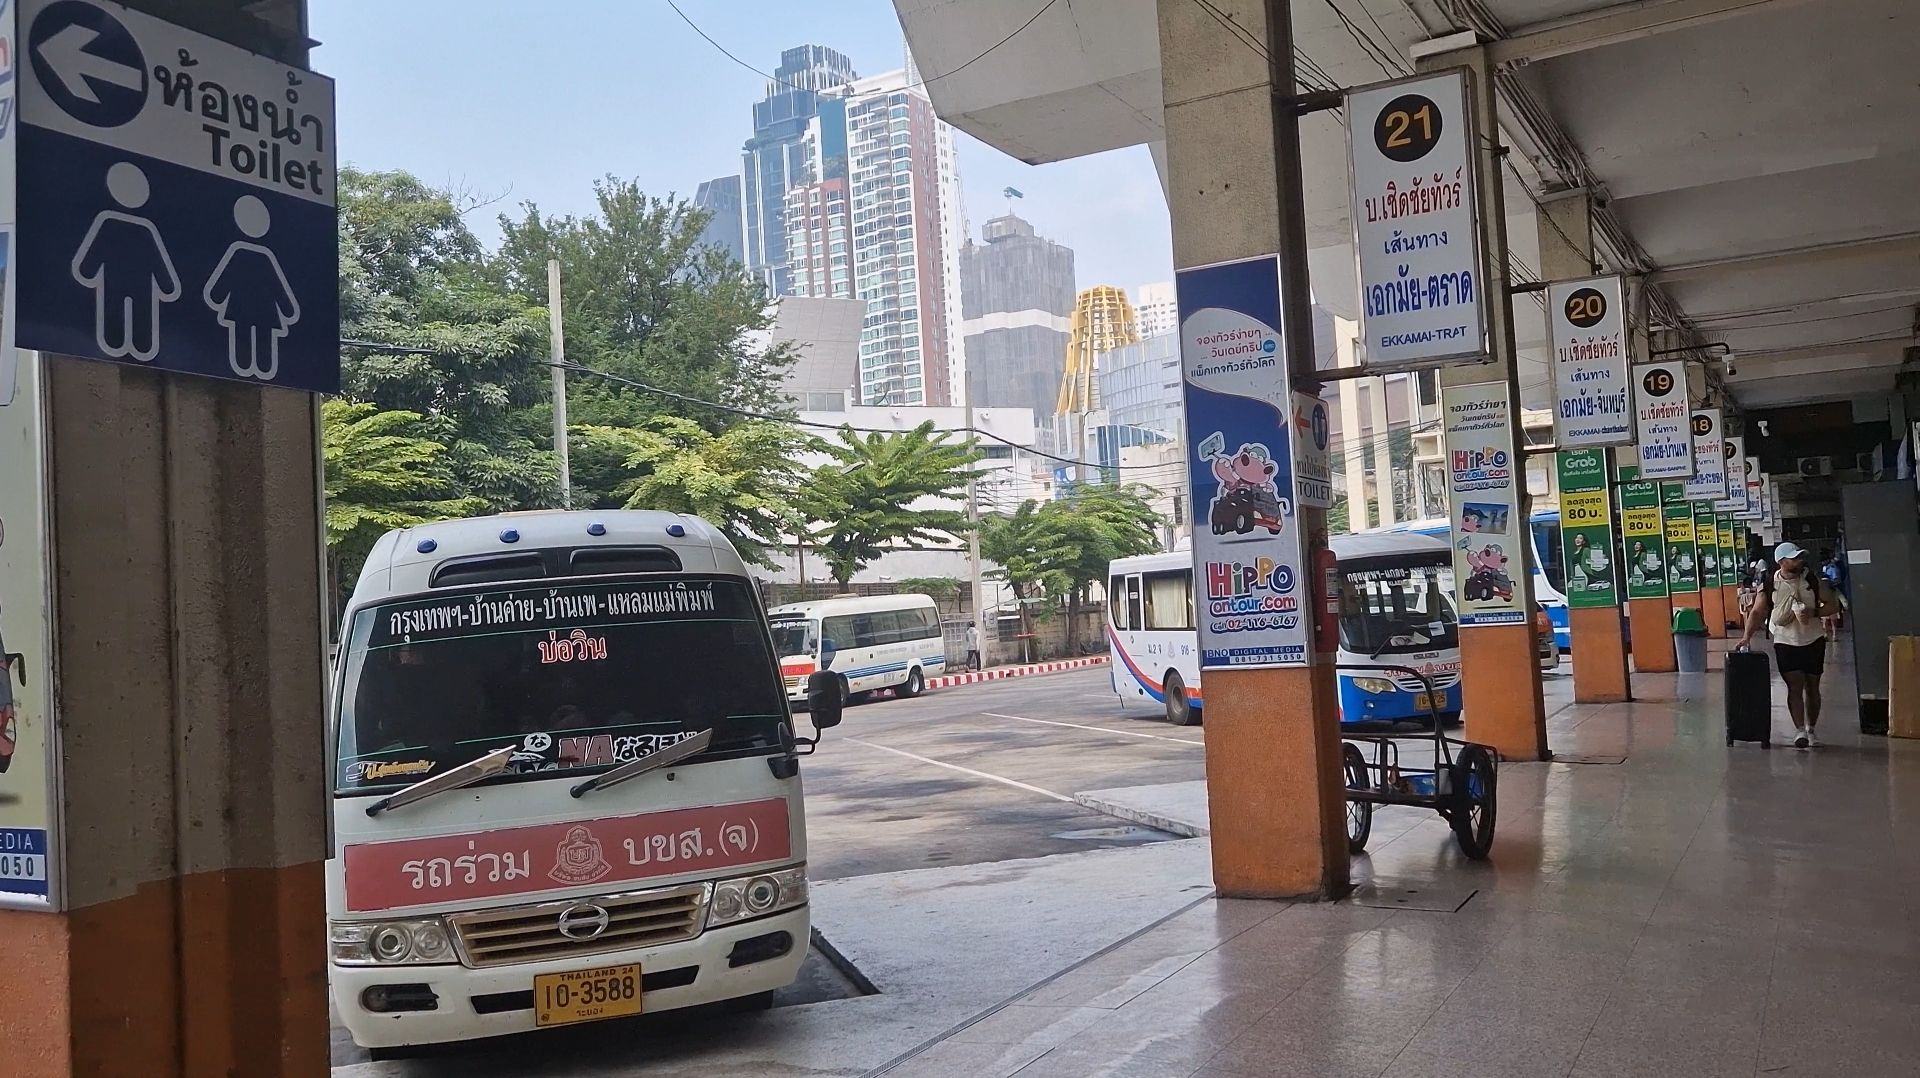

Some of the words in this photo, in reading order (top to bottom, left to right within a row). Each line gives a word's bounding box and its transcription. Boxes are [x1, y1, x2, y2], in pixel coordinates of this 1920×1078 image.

[153, 48, 323, 152] ห้องน้ำ
[1385, 105, 1432, 148] 21
[202, 123, 323, 196] Toilet
[1366, 166, 1463, 223] บ.เชิดชัยทัวร์
[1384, 230, 1449, 254] เส้นทาง
[1366, 264, 1473, 317] เอกมัย-ตราด
[1569, 295, 1603, 320] 20
[1381, 326, 1467, 348] EKKAMAI-TRAT
[1559, 332, 1619, 363] บ.เชิดชัยทัวร์
[1647, 375, 1670, 391] 19
[1692, 420, 1709, 431] 18
[1565, 456, 1597, 469] Grab
[1298, 481, 1331, 500] TOILET
[1568, 508, 1586, 519] 80
[1629, 522, 1644, 531] 80
[1212, 596, 1297, 616] ontour.com
[1227, 616, 1297, 630] 02-116-6767
[538, 629, 608, 664] บ่อวิน
[1234, 648, 1269, 656] DIGITAL
[558, 735, 614, 768] NA
[1, 856, 34, 877] 050
[402, 840, 530, 890] รถร่วม
[560, 968, 617, 981] THAILAND
[566, 975, 635, 1010] 10-3588
[576, 1007, 604, 1017] ระยอง
